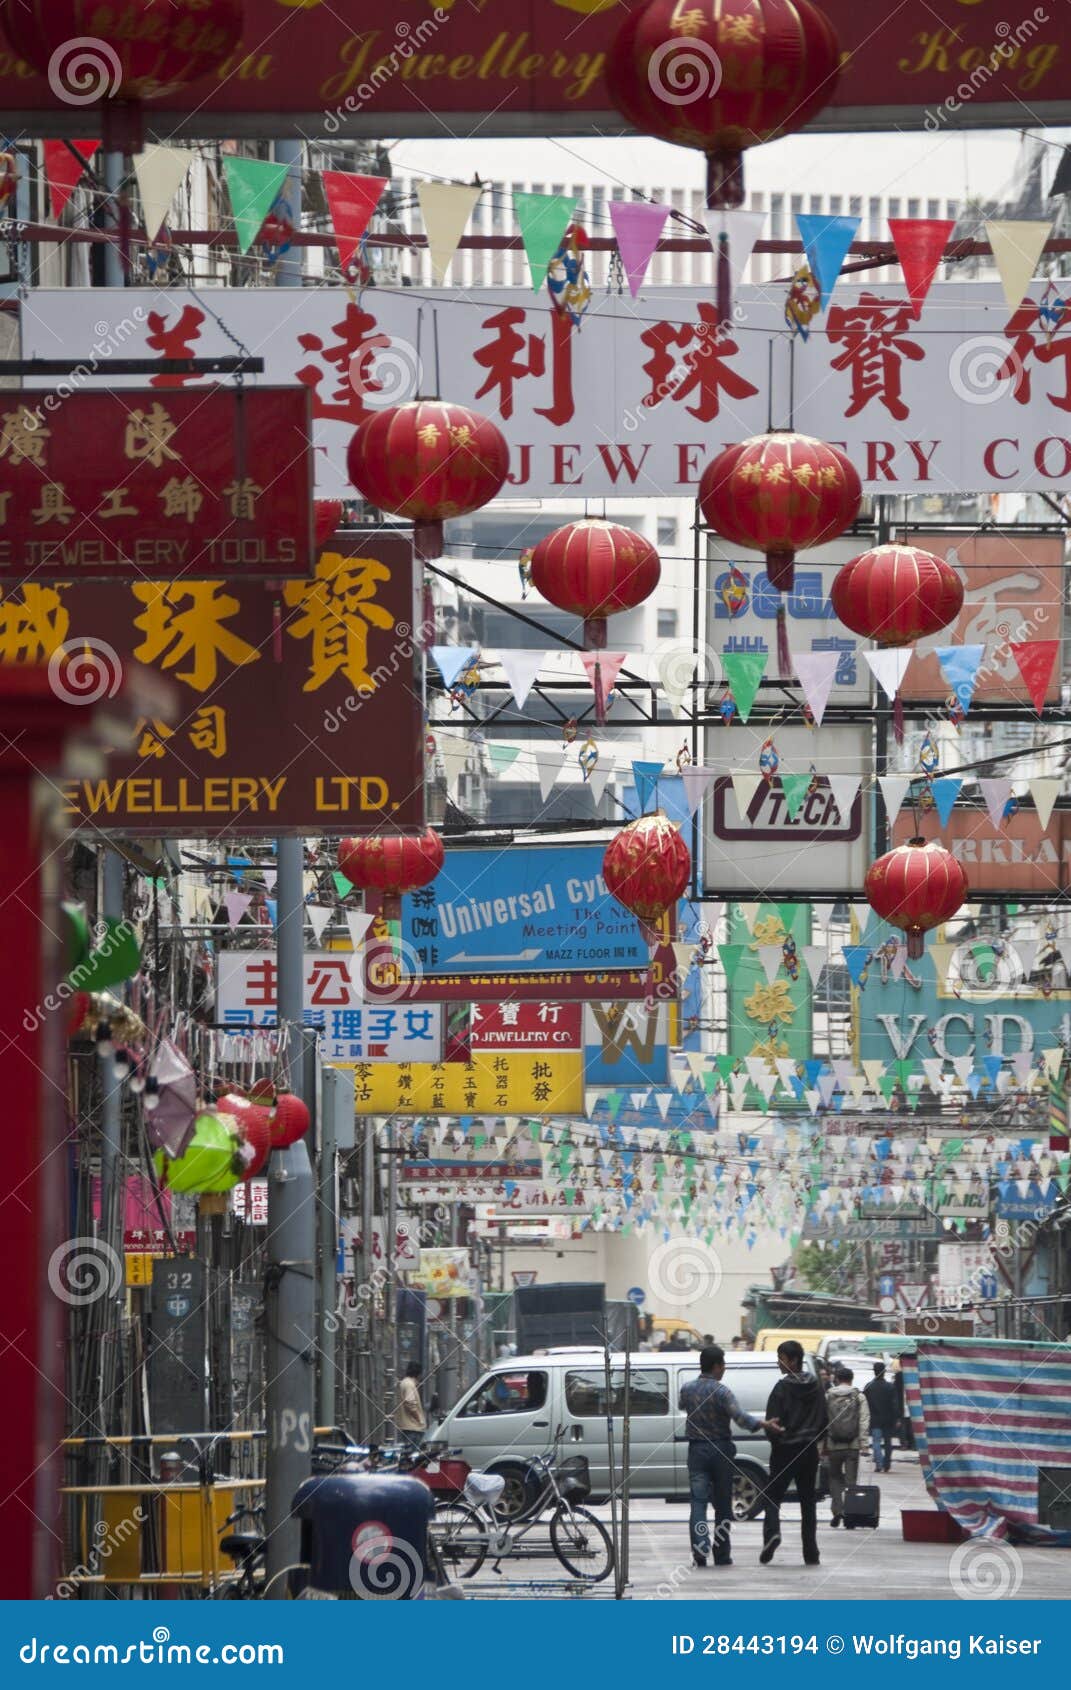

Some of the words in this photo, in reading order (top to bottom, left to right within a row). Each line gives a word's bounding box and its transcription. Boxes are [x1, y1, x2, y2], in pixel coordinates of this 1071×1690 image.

[417, 424, 478, 448] 香港
[25, 540, 188, 566] JEWELLERY
[207, 538, 295, 564] TOOLS
[713, 571, 838, 619] SEG
[62, 777, 286, 813] EWELLERY
[315, 776, 400, 811] LTD.
[437, 883, 555, 938] Universal
[573, 907, 600, 920] The
[522, 922, 587, 939] Meeting
[597, 921, 636, 935] Point
[546, 949, 573, 960] MAZZ
[577, 948, 610, 959] FLOOR
[481, 1031, 549, 1042] JEWELLERY
[877, 1013, 1034, 1061] VCD
[167, 1273, 193, 1289] 32
